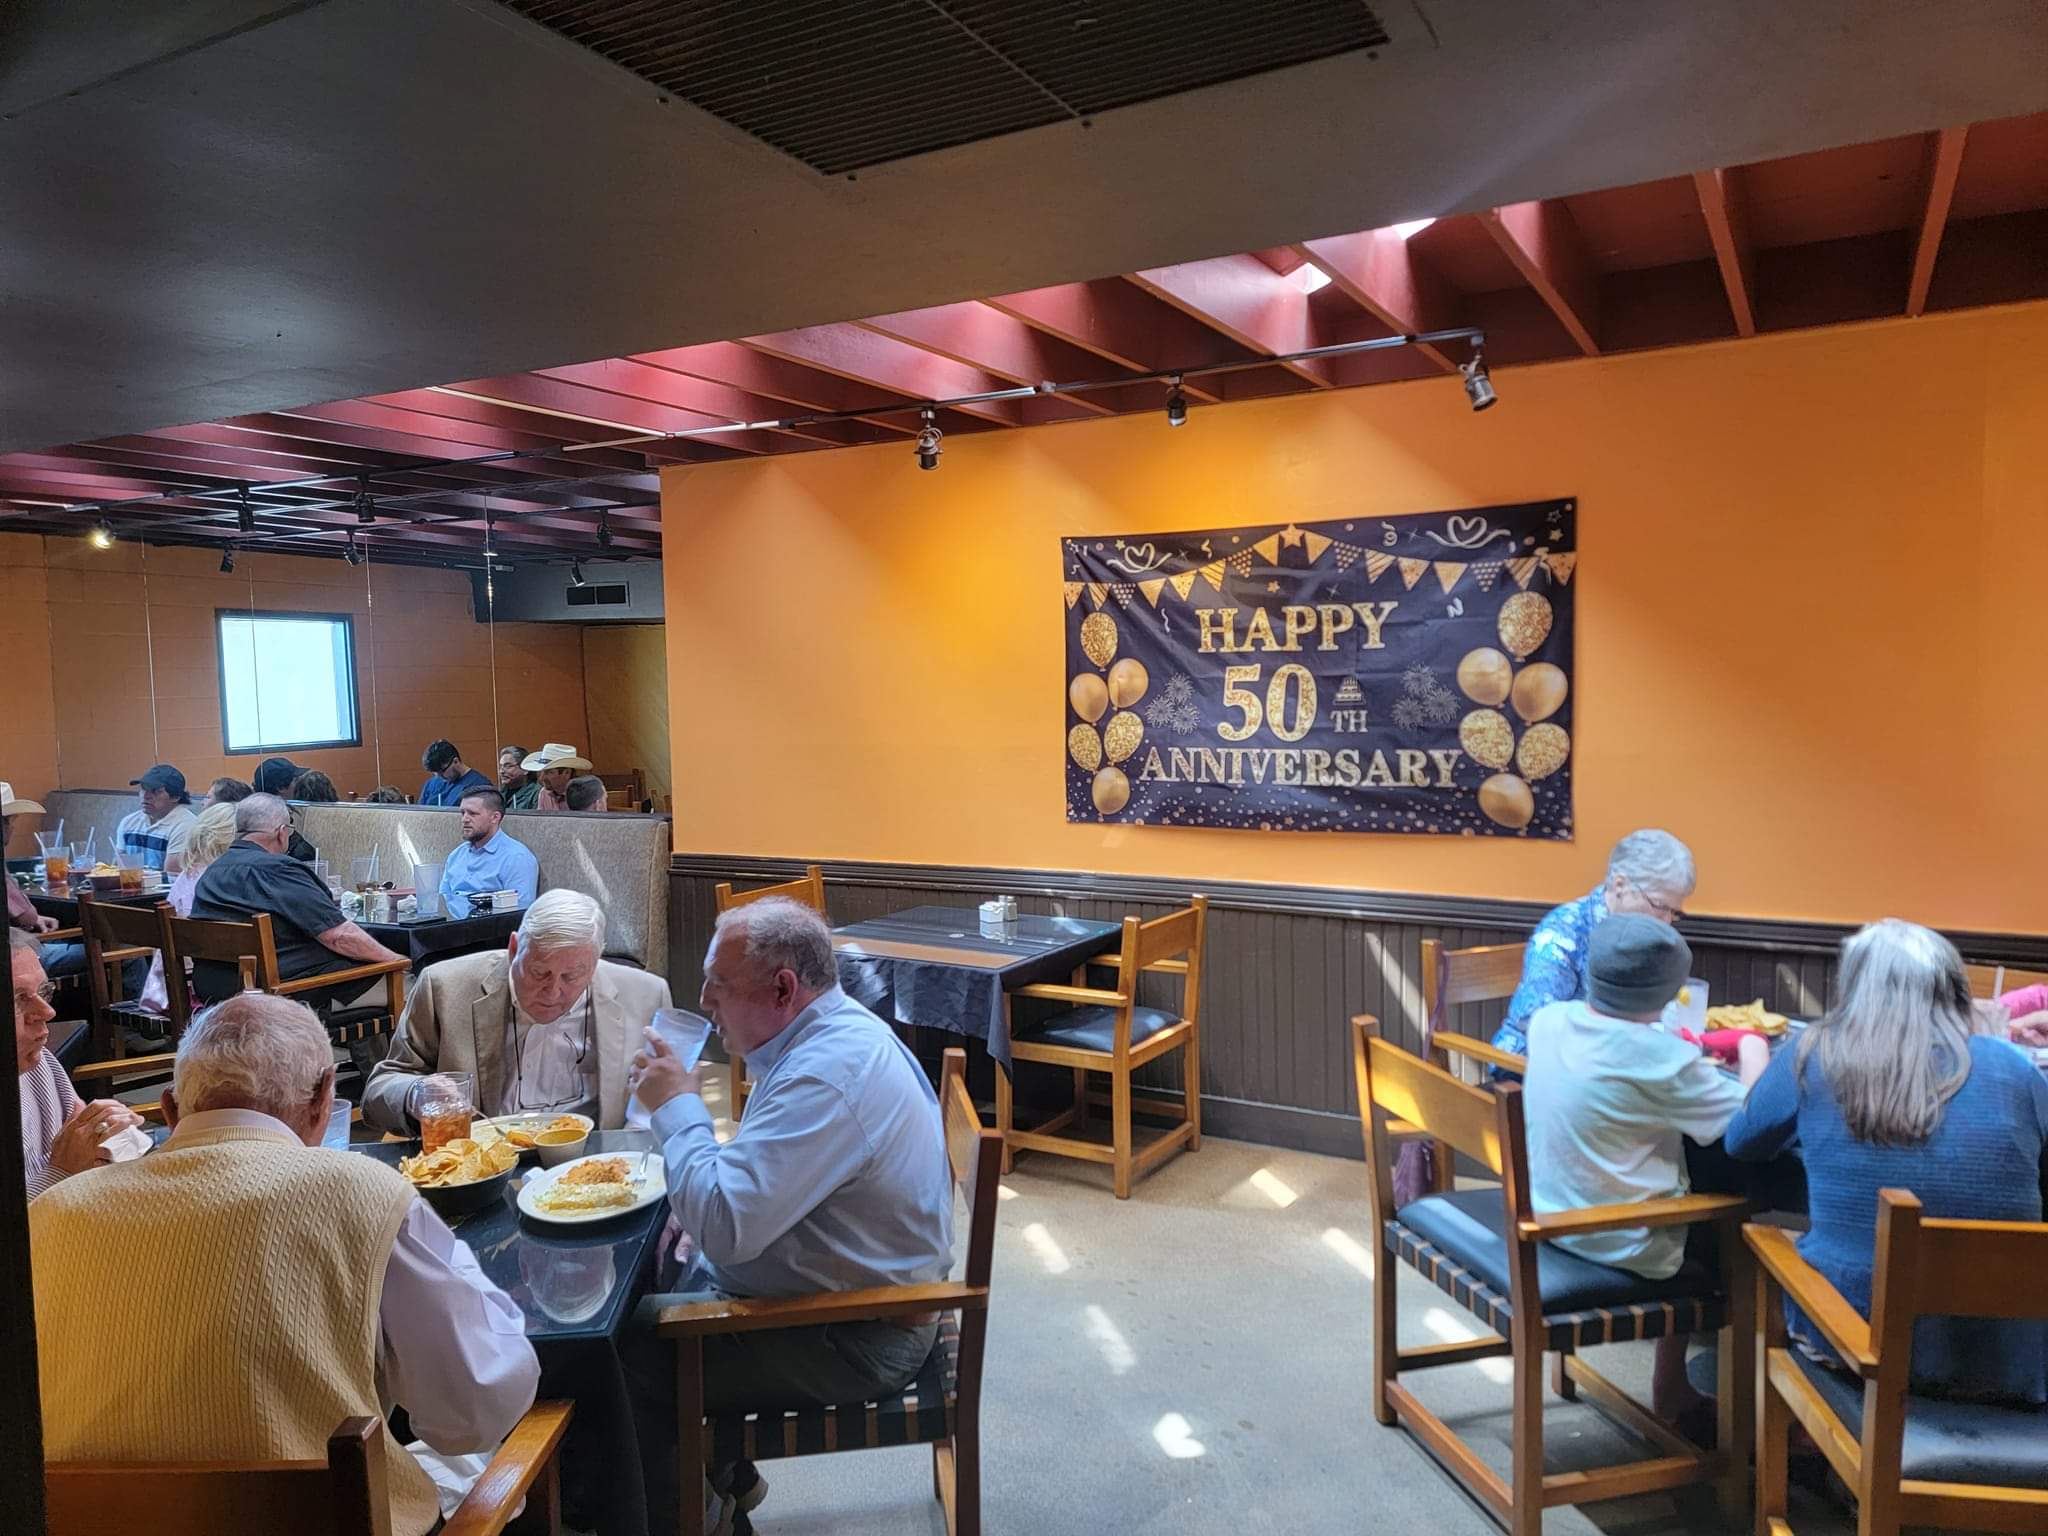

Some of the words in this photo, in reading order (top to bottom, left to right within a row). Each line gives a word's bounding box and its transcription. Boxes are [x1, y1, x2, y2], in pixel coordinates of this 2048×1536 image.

[1195, 602, 1398, 653] HAPPY
[1217, 663, 1317, 741] 50
[1331, 710, 1368, 733] TH
[1141, 747, 1463, 788] ANNIVERSARY
